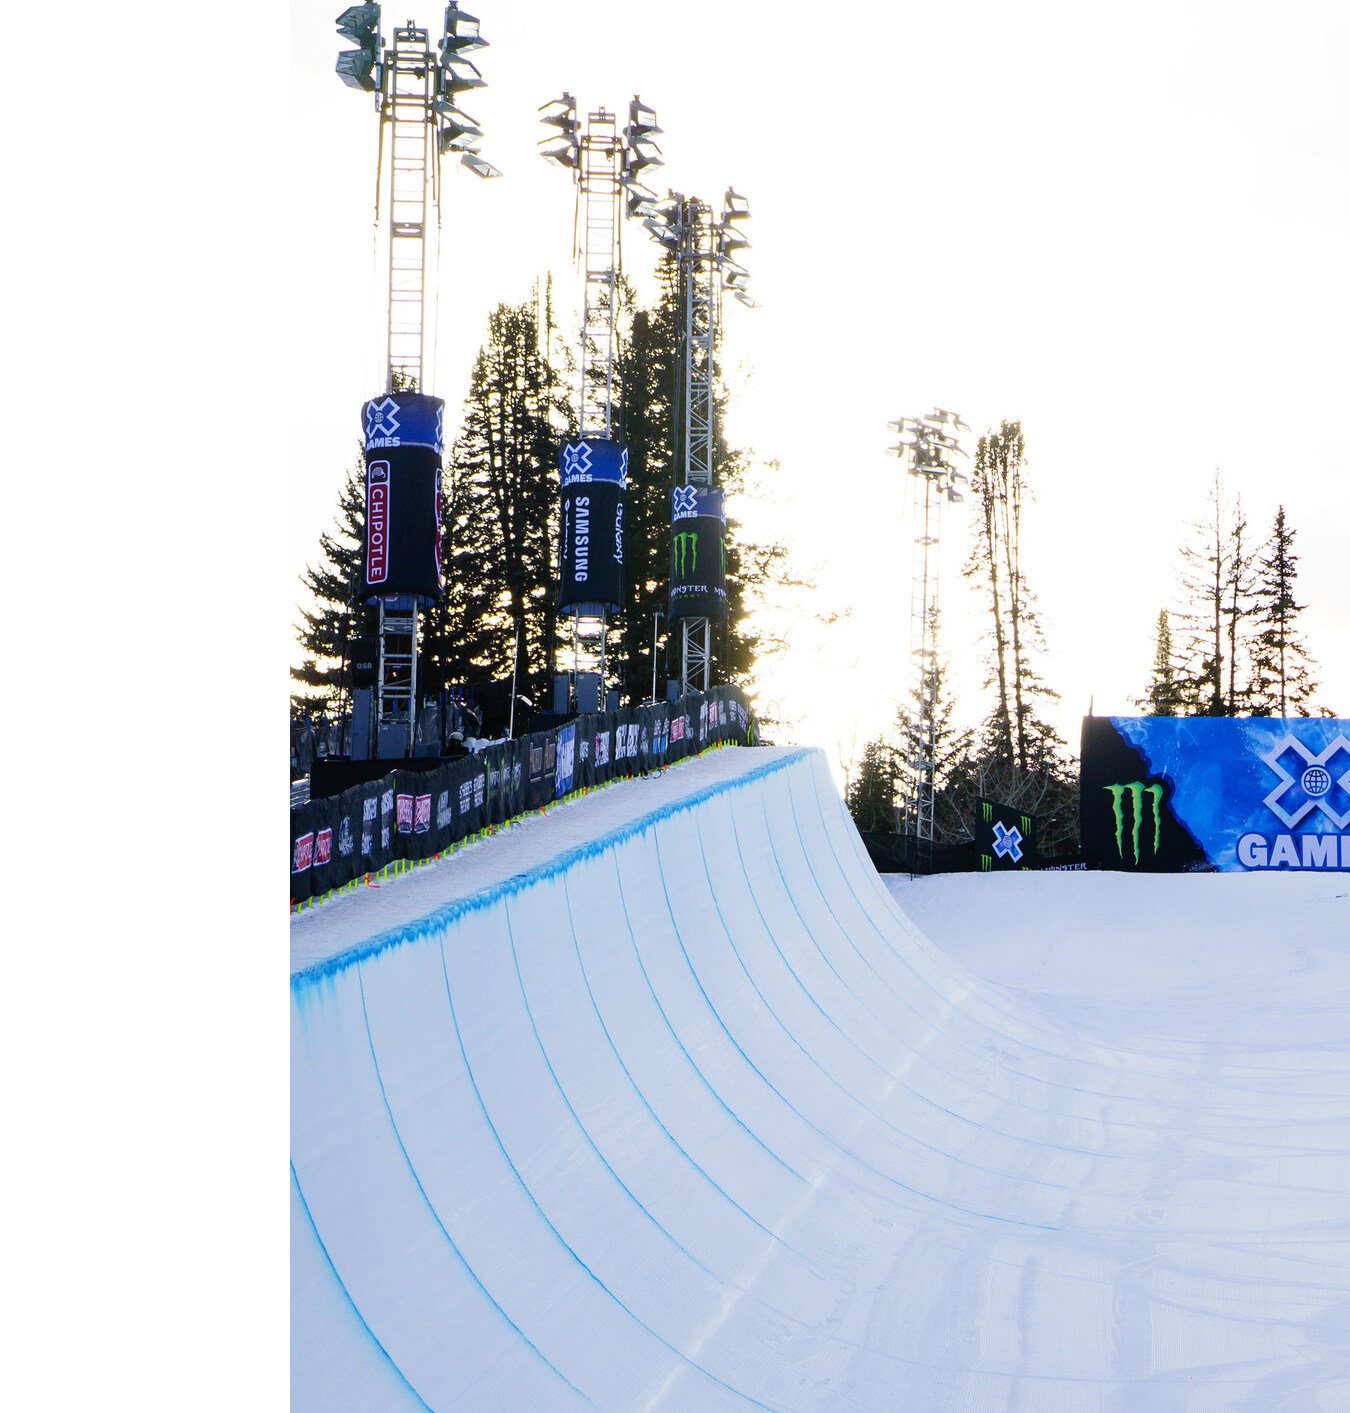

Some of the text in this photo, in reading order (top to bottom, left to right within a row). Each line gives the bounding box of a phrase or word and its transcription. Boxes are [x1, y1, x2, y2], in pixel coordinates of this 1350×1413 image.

[564, 473, 593, 487] GAMES
[371, 488, 384, 578] CHIPOTLE
[575, 496, 590, 583] SAMSUNG
[674, 510, 698, 522] GAMES
